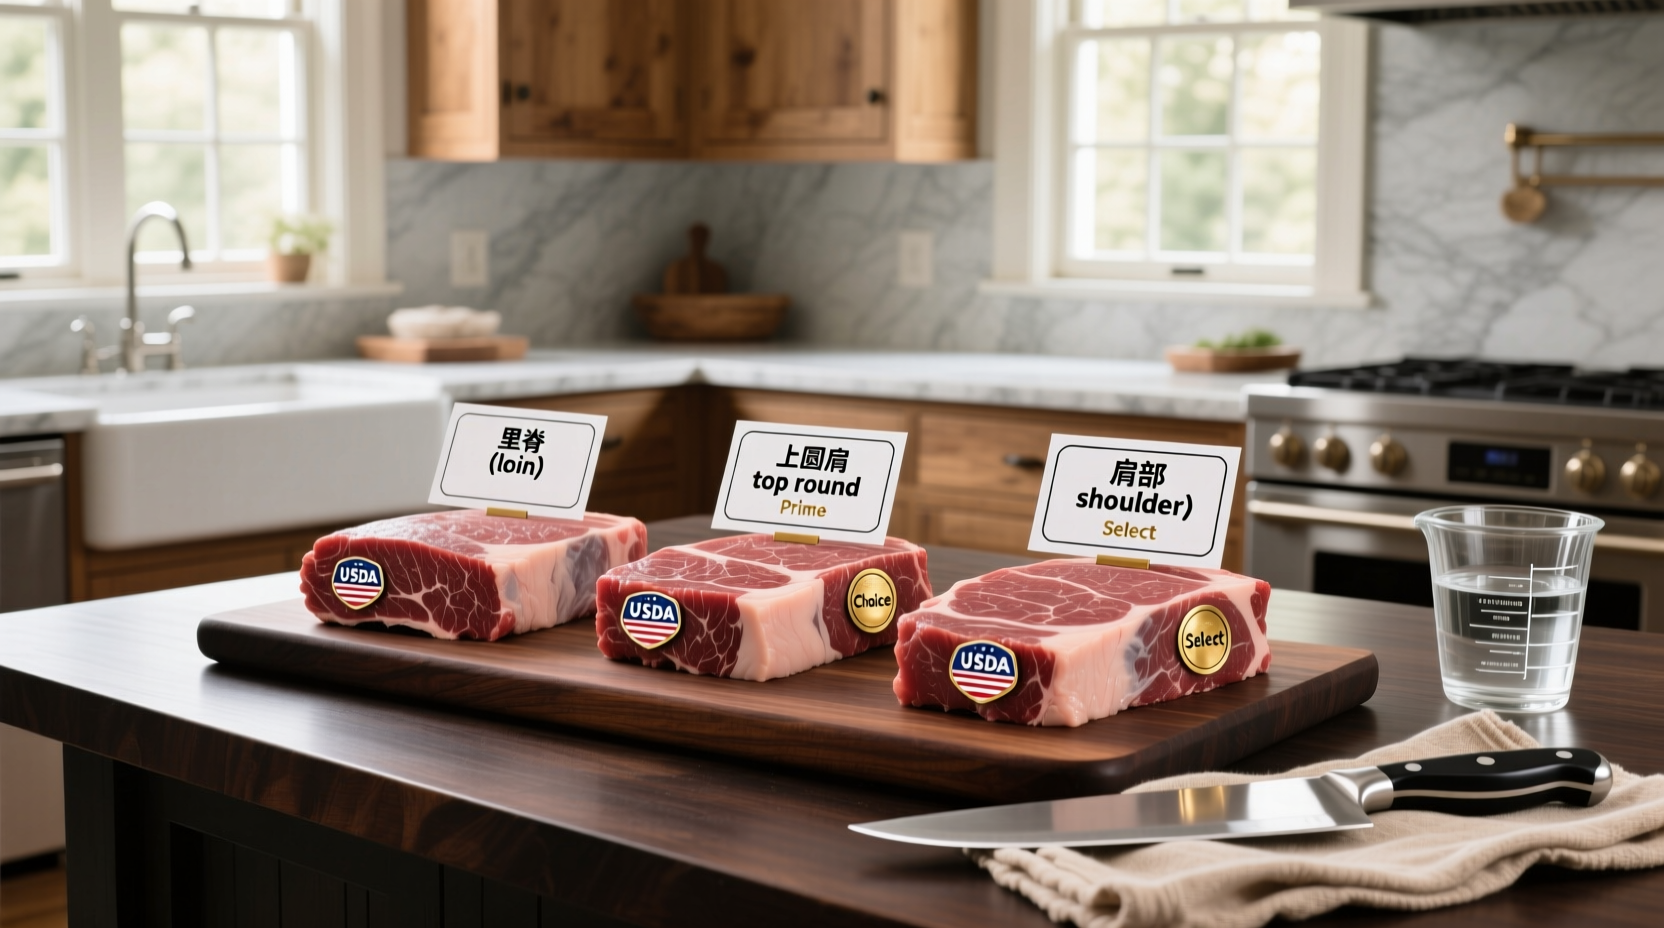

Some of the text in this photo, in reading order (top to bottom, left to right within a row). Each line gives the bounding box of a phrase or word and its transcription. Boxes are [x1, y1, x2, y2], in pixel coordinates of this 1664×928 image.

[497, 427, 545, 454] 里脊
[489, 452, 544, 481] (loin)
[1109, 458, 1167, 489] 肩部
[752, 471, 861, 497] top round
[780, 499, 827, 518] Prime
[1075, 487, 1193, 521] shoulder)
[1102, 520, 1157, 540] Select
[340, 566, 379, 584] USDA
[629, 601, 675, 622] USDA
[853, 593, 891, 608] Choice
[1185, 630, 1225, 649] Select
[960, 651, 1011, 674] USDA
